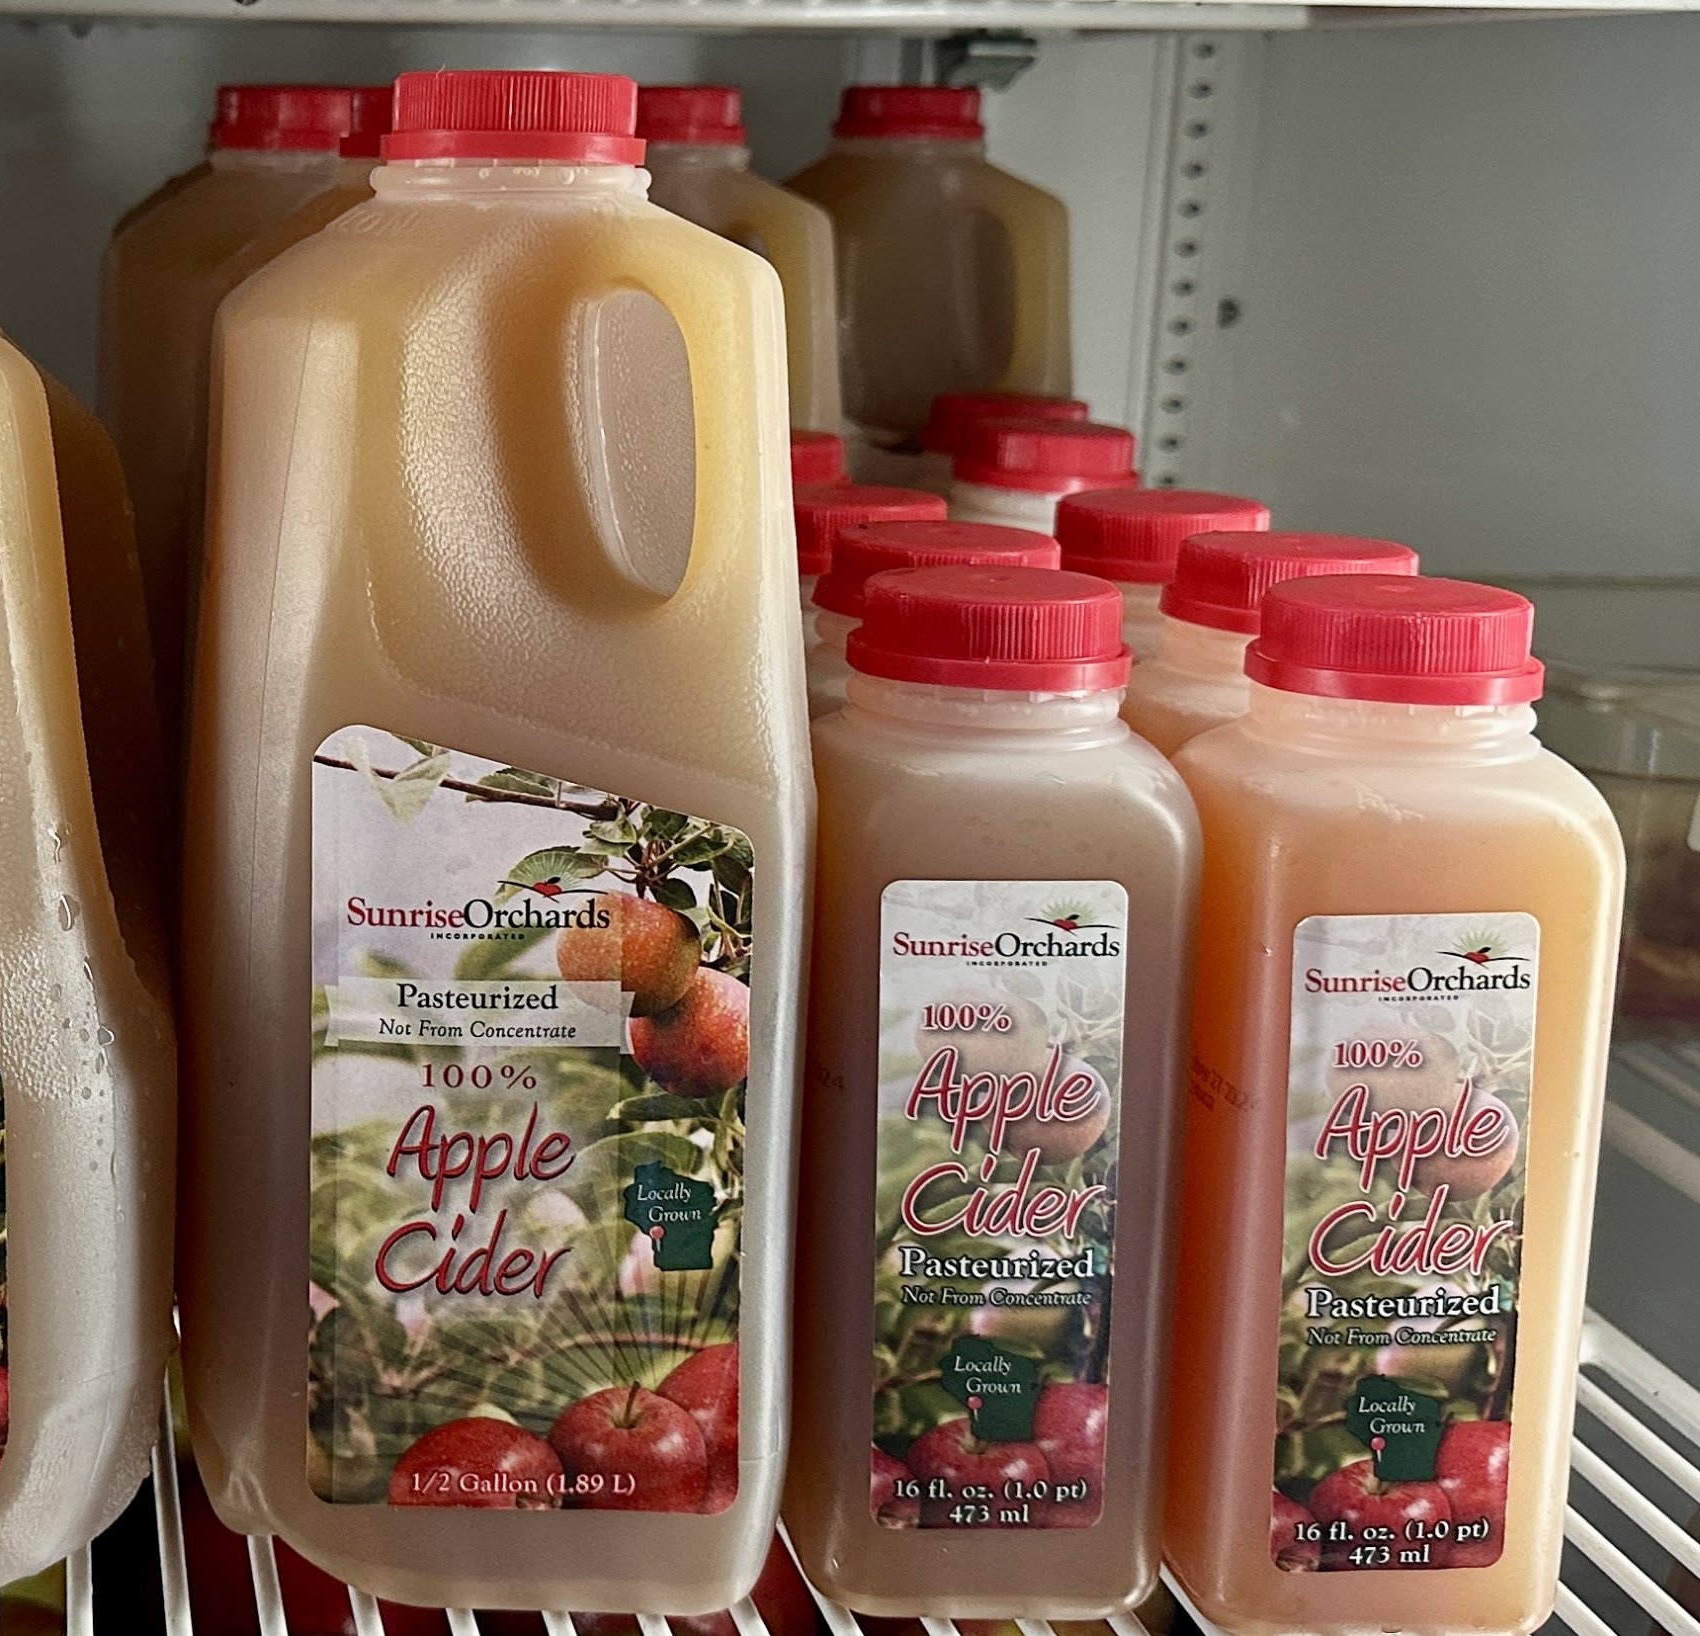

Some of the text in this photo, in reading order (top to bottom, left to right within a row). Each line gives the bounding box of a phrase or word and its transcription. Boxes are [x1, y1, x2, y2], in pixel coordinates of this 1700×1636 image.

[347, 895, 611, 932] SunriseOrchards
[430, 932, 526, 940] INCORPORATED
[893, 931, 1120, 960] SunriseOrchards
[1305, 966, 1531, 994] SunriseOrchards
[397, 982, 559, 1012] Pasteurized
[379, 1019, 577, 1041] Not From Concentrate
[921, 1004, 1011, 1032] 100%
[1333, 1041, 1422, 1068] 100%
[421, 1064, 538, 1090] 100%
[905, 1044, 1101, 1155] Apple
[1315, 1082, 1511, 1193] Apple
[387, 1102, 576, 1211] Apple
[637, 1183, 692, 1204] Locally
[900, 1148, 1108, 1238] Cider
[648, 1205, 701, 1224] Grown
[1307, 1185, 1513, 1278] Cider
[375, 1209, 572, 1298] Cider
[900, 1246, 1095, 1280] Pasteurized
[901, 1286, 1092, 1307] Not From Concentrate
[1306, 1285, 1500, 1319] Pasteurized
[1307, 1326, 1496, 1346] Not From Concentrate
[954, 1354, 1011, 1376] Locally
[966, 1375, 1021, 1395] Grown
[1358, 1395, 1416, 1417] Locally
[1369, 1416, 1425, 1435] Grown
[411, 1471, 636, 1496] 1/2 Gallon (1.89 L)
[893, 1479, 1086, 1501] 16 fl. oz. (1.0 pt)
[948, 1504, 1030, 1523] 473 ml
[1295, 1520, 1489, 1544] 16 fl. oz. (1.0 pt)
[1348, 1544, 1430, 1564] 473 ml
